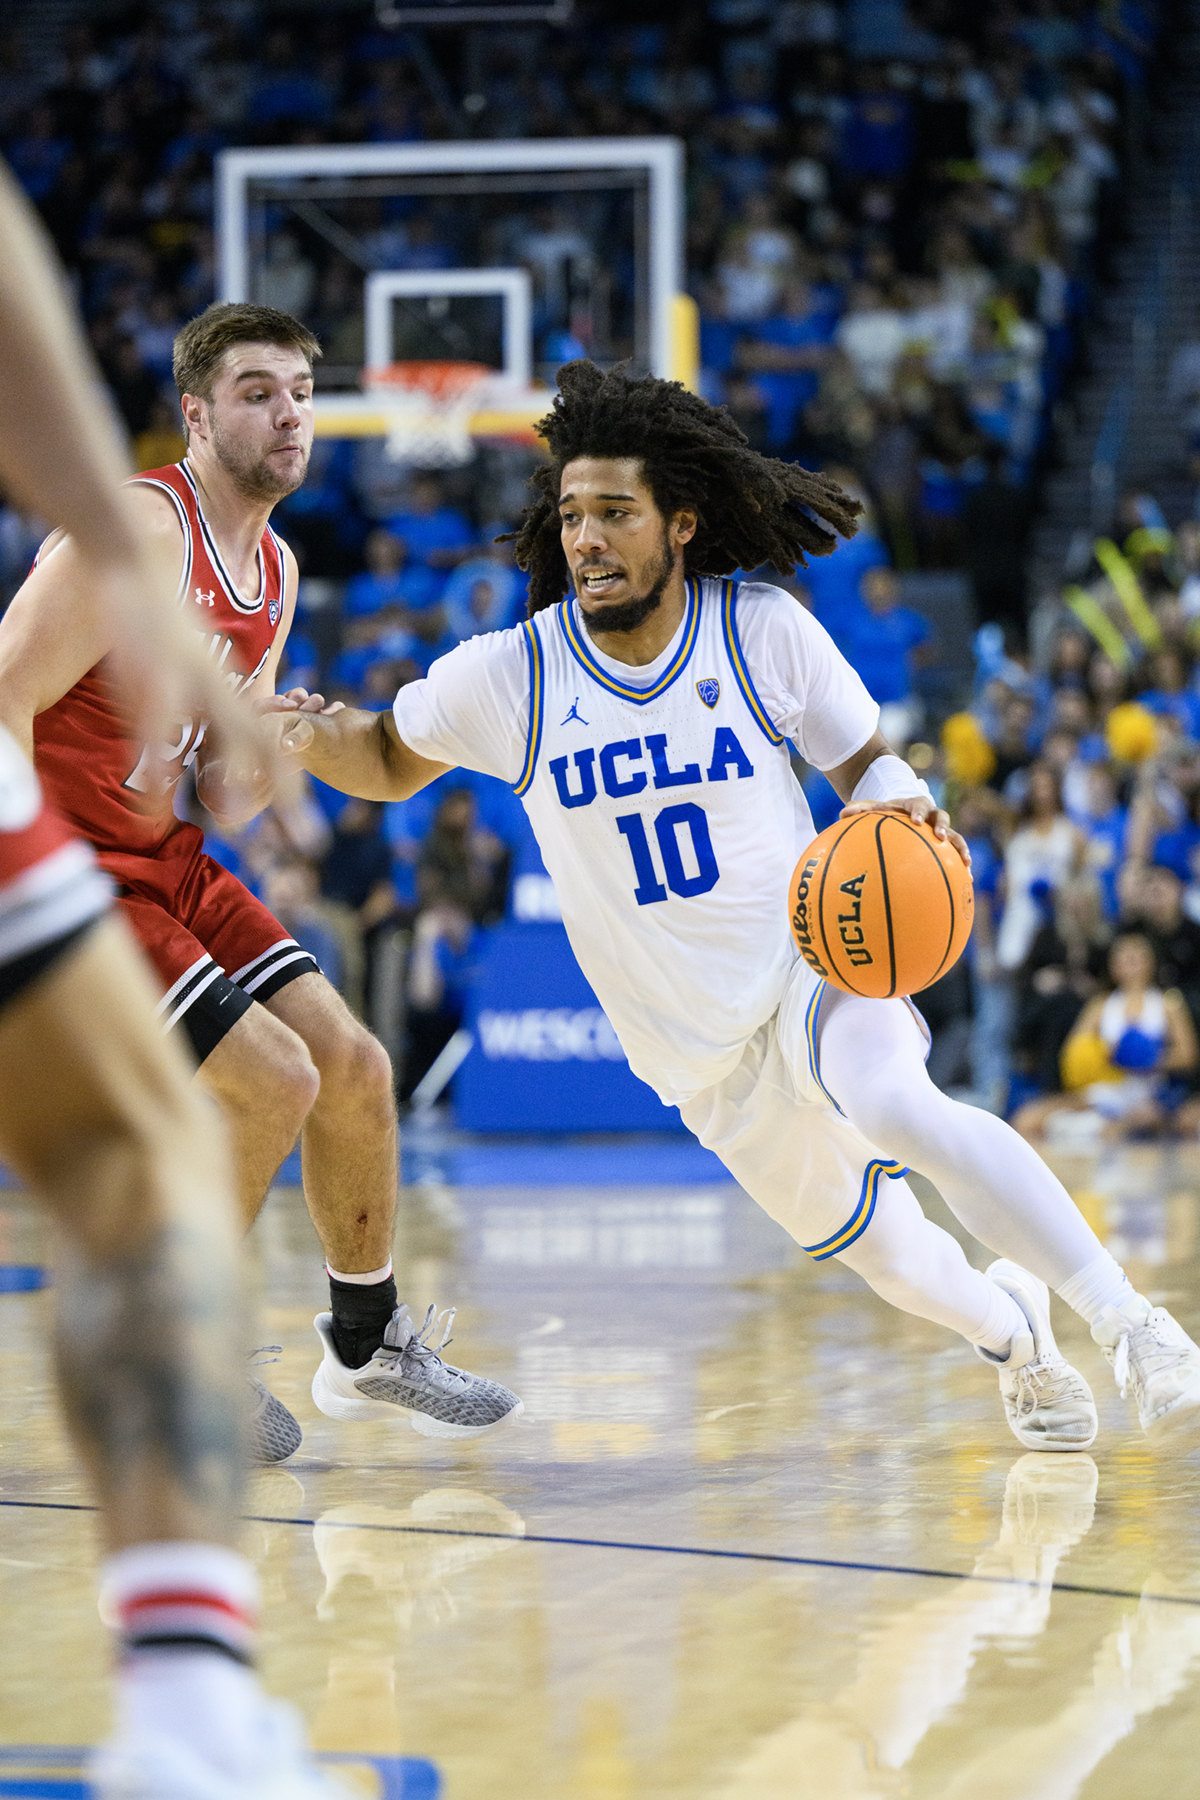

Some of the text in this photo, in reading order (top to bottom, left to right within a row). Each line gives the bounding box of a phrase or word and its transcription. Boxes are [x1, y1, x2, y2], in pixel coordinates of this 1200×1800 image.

[704, 690, 717, 703] 12
[549, 727, 754, 809] UCLA
[615, 802, 720, 906] 10
[793, 857, 829, 977] Wilson
[838, 873, 874, 966] UCLA
